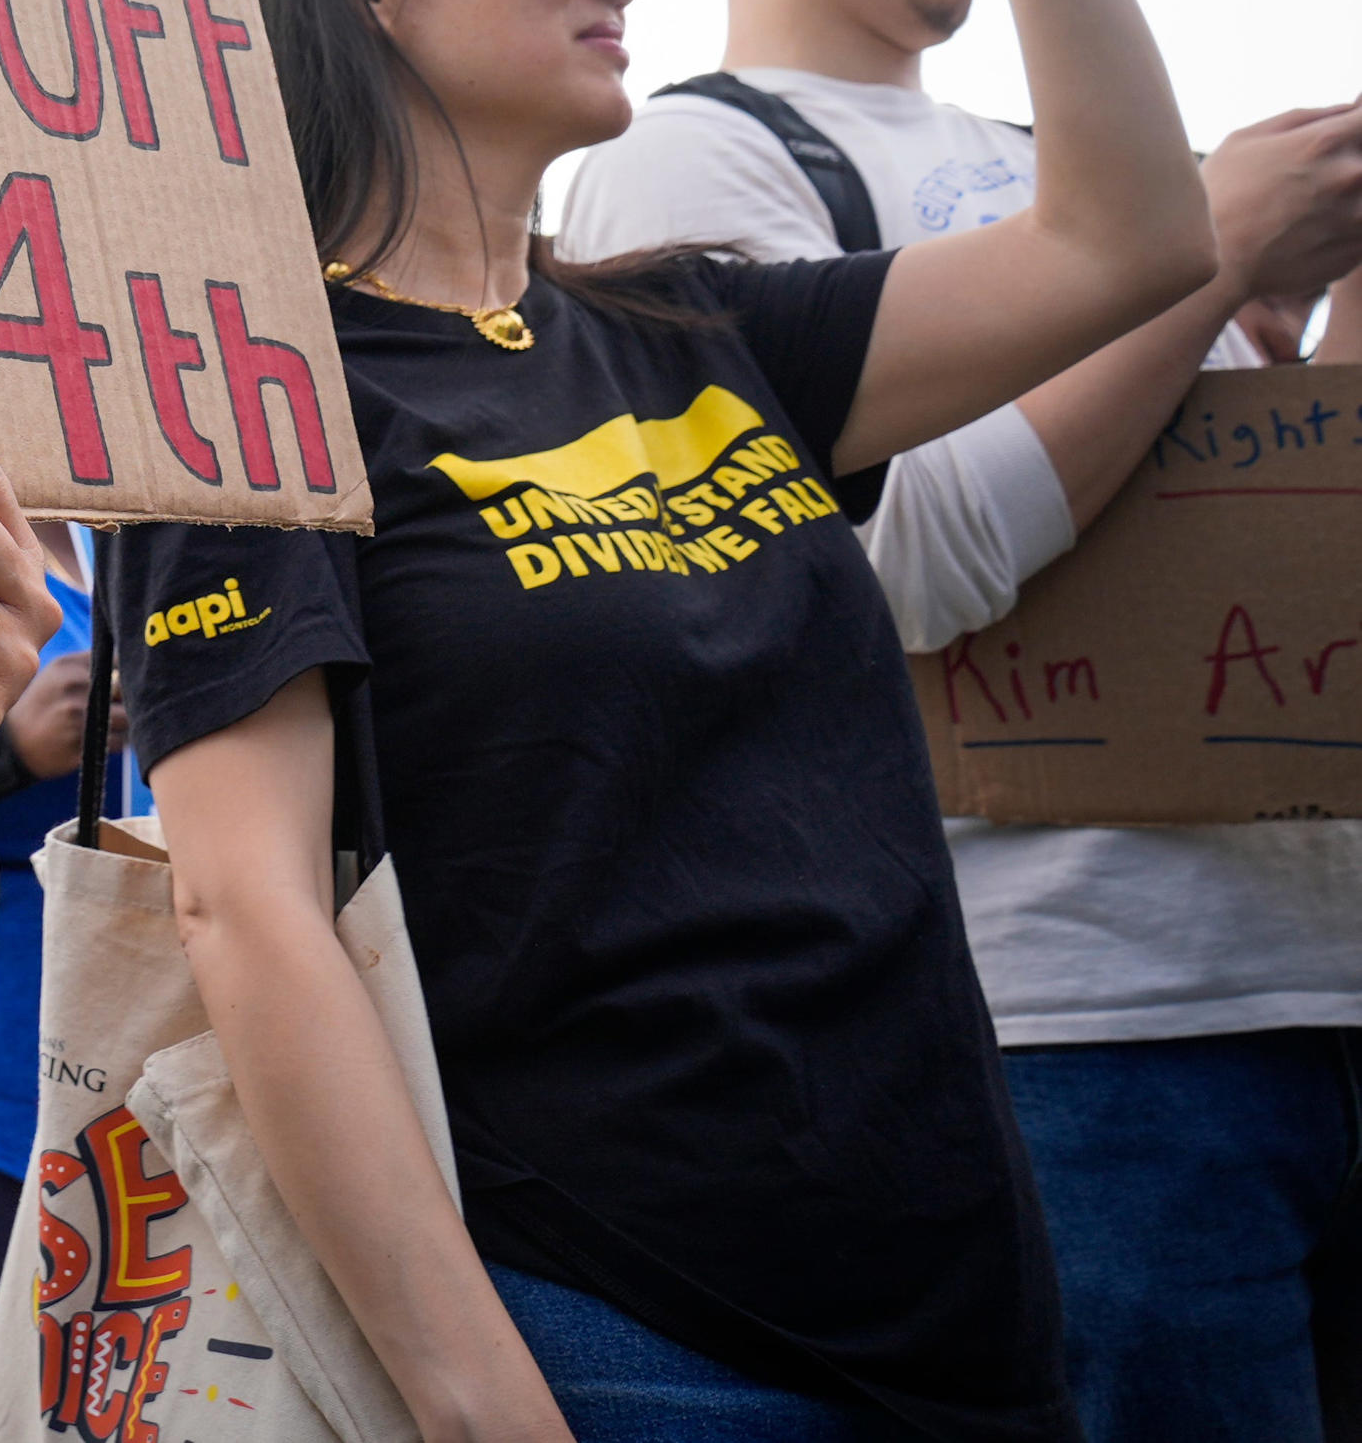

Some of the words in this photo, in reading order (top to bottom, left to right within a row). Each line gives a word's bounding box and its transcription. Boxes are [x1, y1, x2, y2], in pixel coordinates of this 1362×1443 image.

[479, 486, 660, 540] UNITED
[667, 435, 800, 527] STAND
[145, 577, 246, 647] aapi
[943, 631, 1099, 724] Kim
[1204, 604, 1362, 717] Ar
